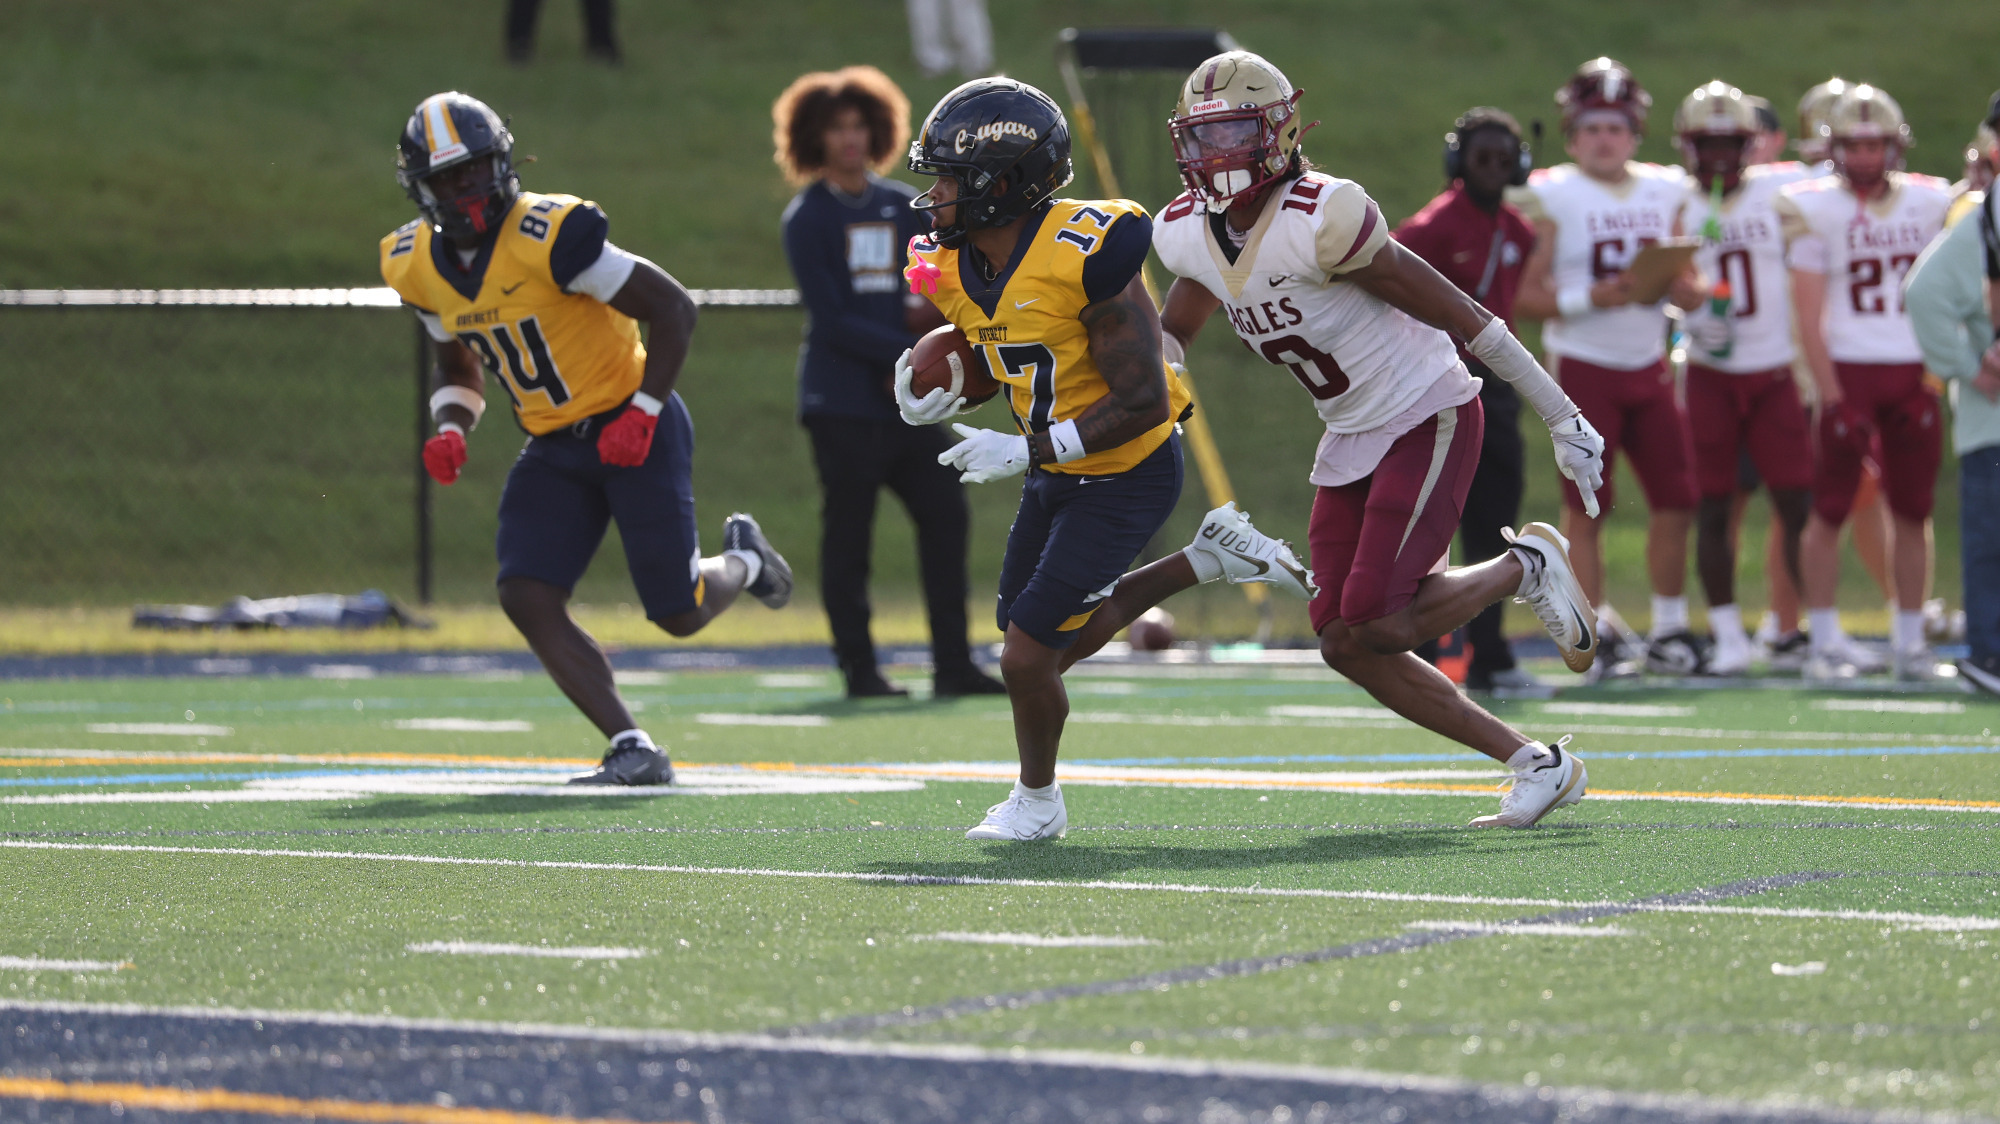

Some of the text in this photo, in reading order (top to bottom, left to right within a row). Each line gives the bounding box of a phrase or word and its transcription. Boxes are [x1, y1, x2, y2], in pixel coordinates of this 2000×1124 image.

[1192, 100, 1224, 113] Riddell
[954, 121, 1038, 155] Cugars
[1281, 176, 1330, 216] 10
[1054, 206, 1117, 256] 17
[978, 325, 1009, 343] AVERETT
[1221, 296, 1304, 336] AGLES
[1239, 334, 1351, 401] 0
[1201, 521, 1283, 561] VAPOR
